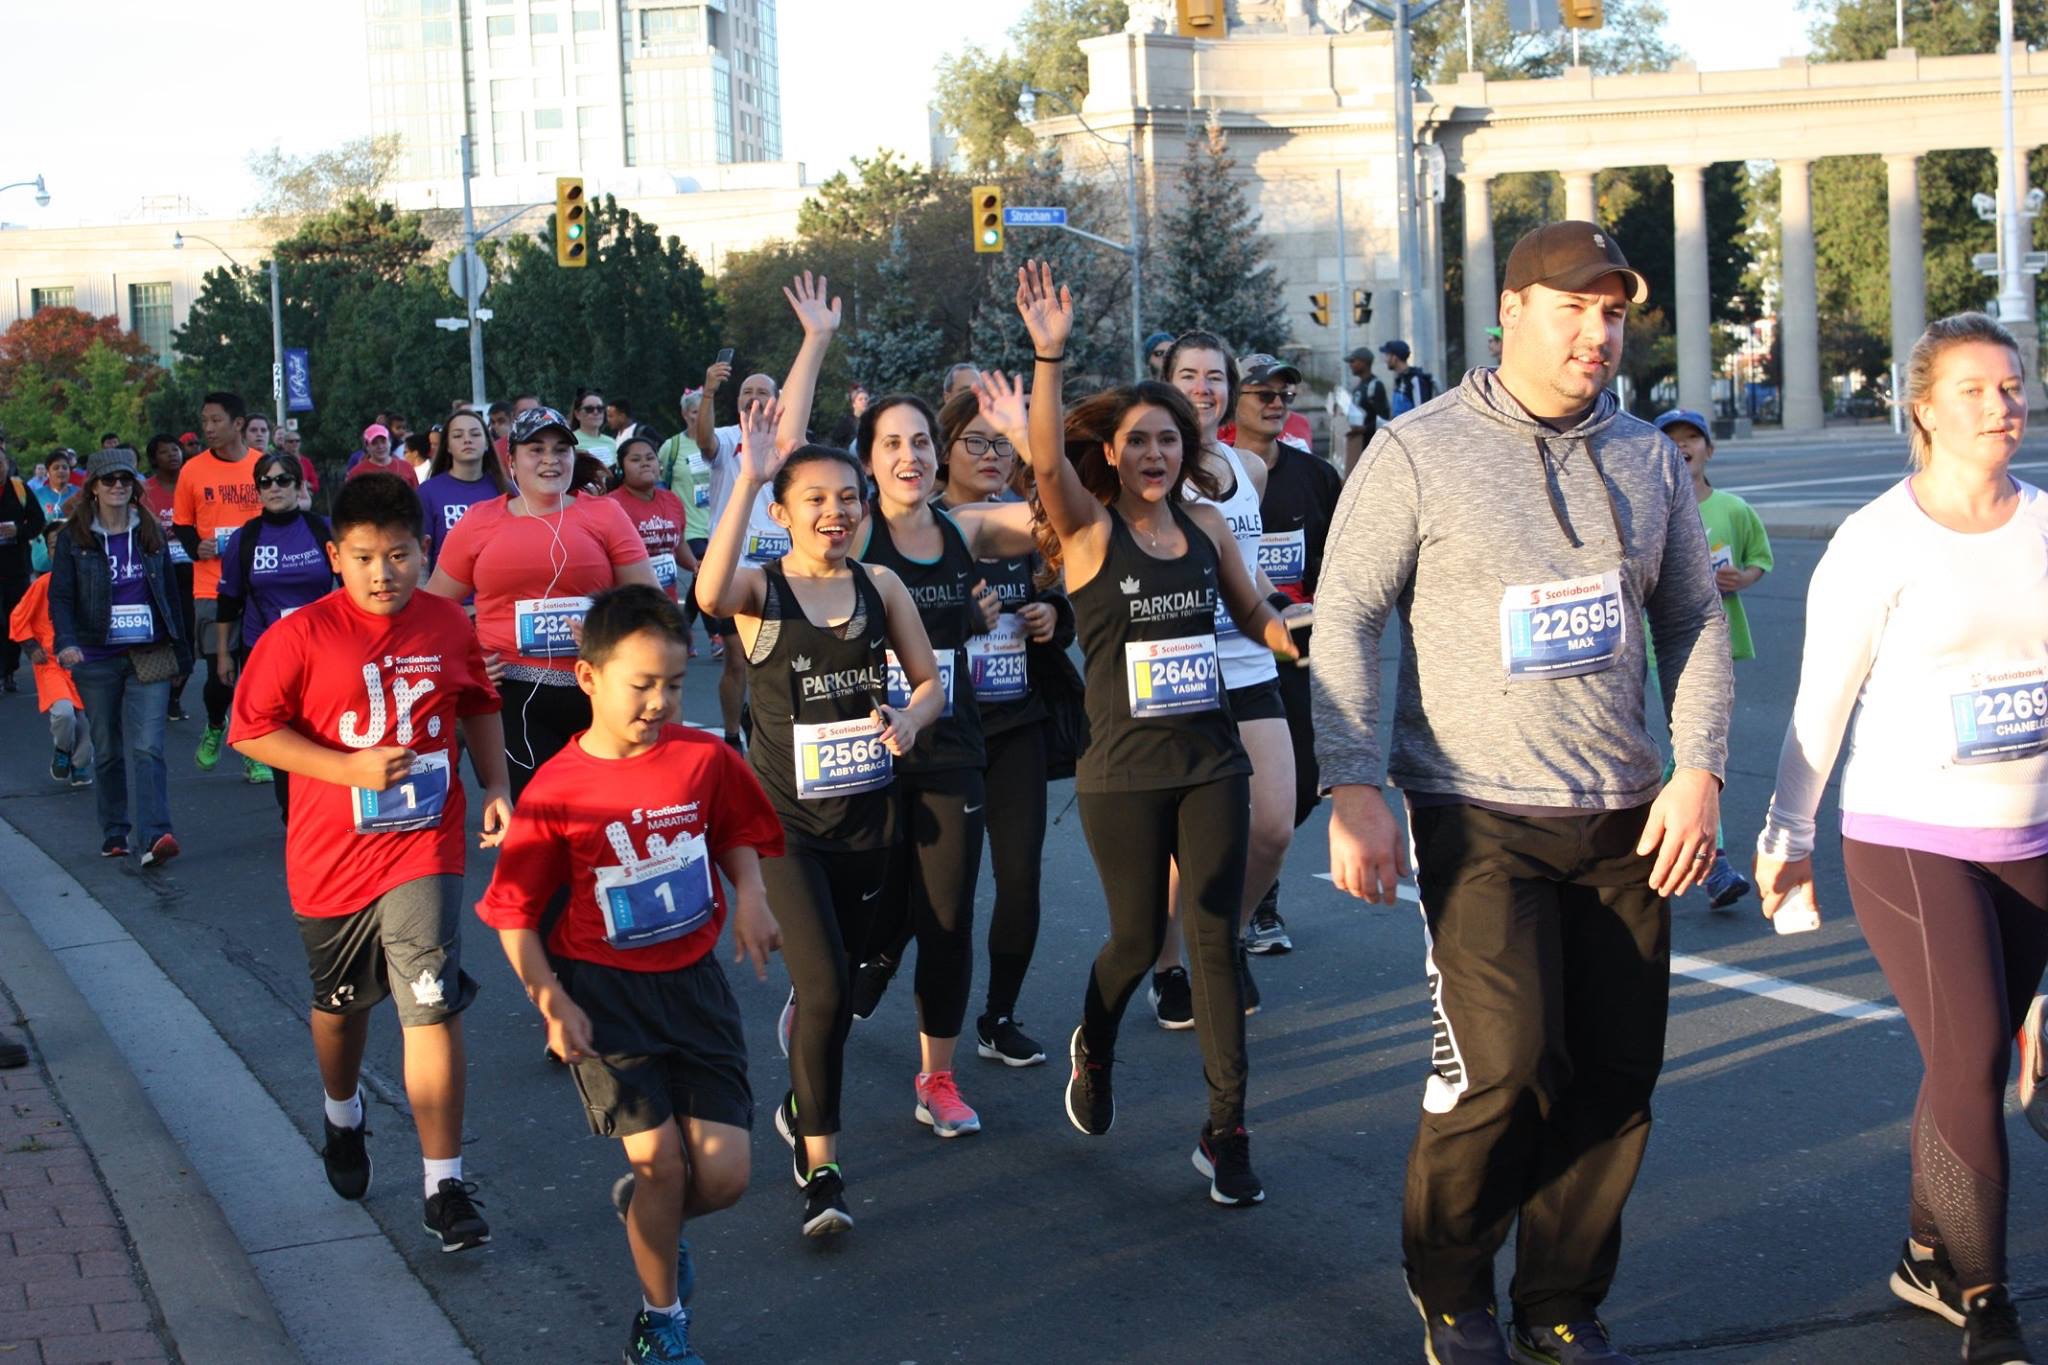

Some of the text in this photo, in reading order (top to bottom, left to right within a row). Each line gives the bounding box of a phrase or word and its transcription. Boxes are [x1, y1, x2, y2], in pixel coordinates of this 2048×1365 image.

[1010, 210, 1051, 221] Strachan
[218, 485, 237, 496] RUN
[1227, 514, 1261, 532] DALE
[1258, 546, 1301, 564] 2837
[656, 563, 674, 577] 273
[907, 583, 965, 603] RKDALE
[1545, 583, 1602, 600] Scotiabank
[1129, 588, 1214, 618] PARKDALE
[111, 616, 150, 629] 26594
[534, 613, 585, 635] 232
[1531, 598, 1620, 642] 22695
[1161, 643, 1203, 653] Scotiabank
[1568, 636, 1595, 651] MAX
[396, 655, 441, 664] Scotiabank
[395, 664, 441, 674] MARATHON
[1151, 655, 1215, 686] 26402
[1986, 668, 2043, 682] Scotiabank
[1172, 682, 1207, 694] YASMIN
[1974, 687, 2048, 725] 2269
[819, 738, 889, 768] 2566
[829, 760, 886, 777] ABBY GRACE
[400, 782, 416, 809] 1
[646, 801, 700, 818] Scotiabank
[647, 813, 698, 830] MARATHON
[654, 881, 676, 913] 1
